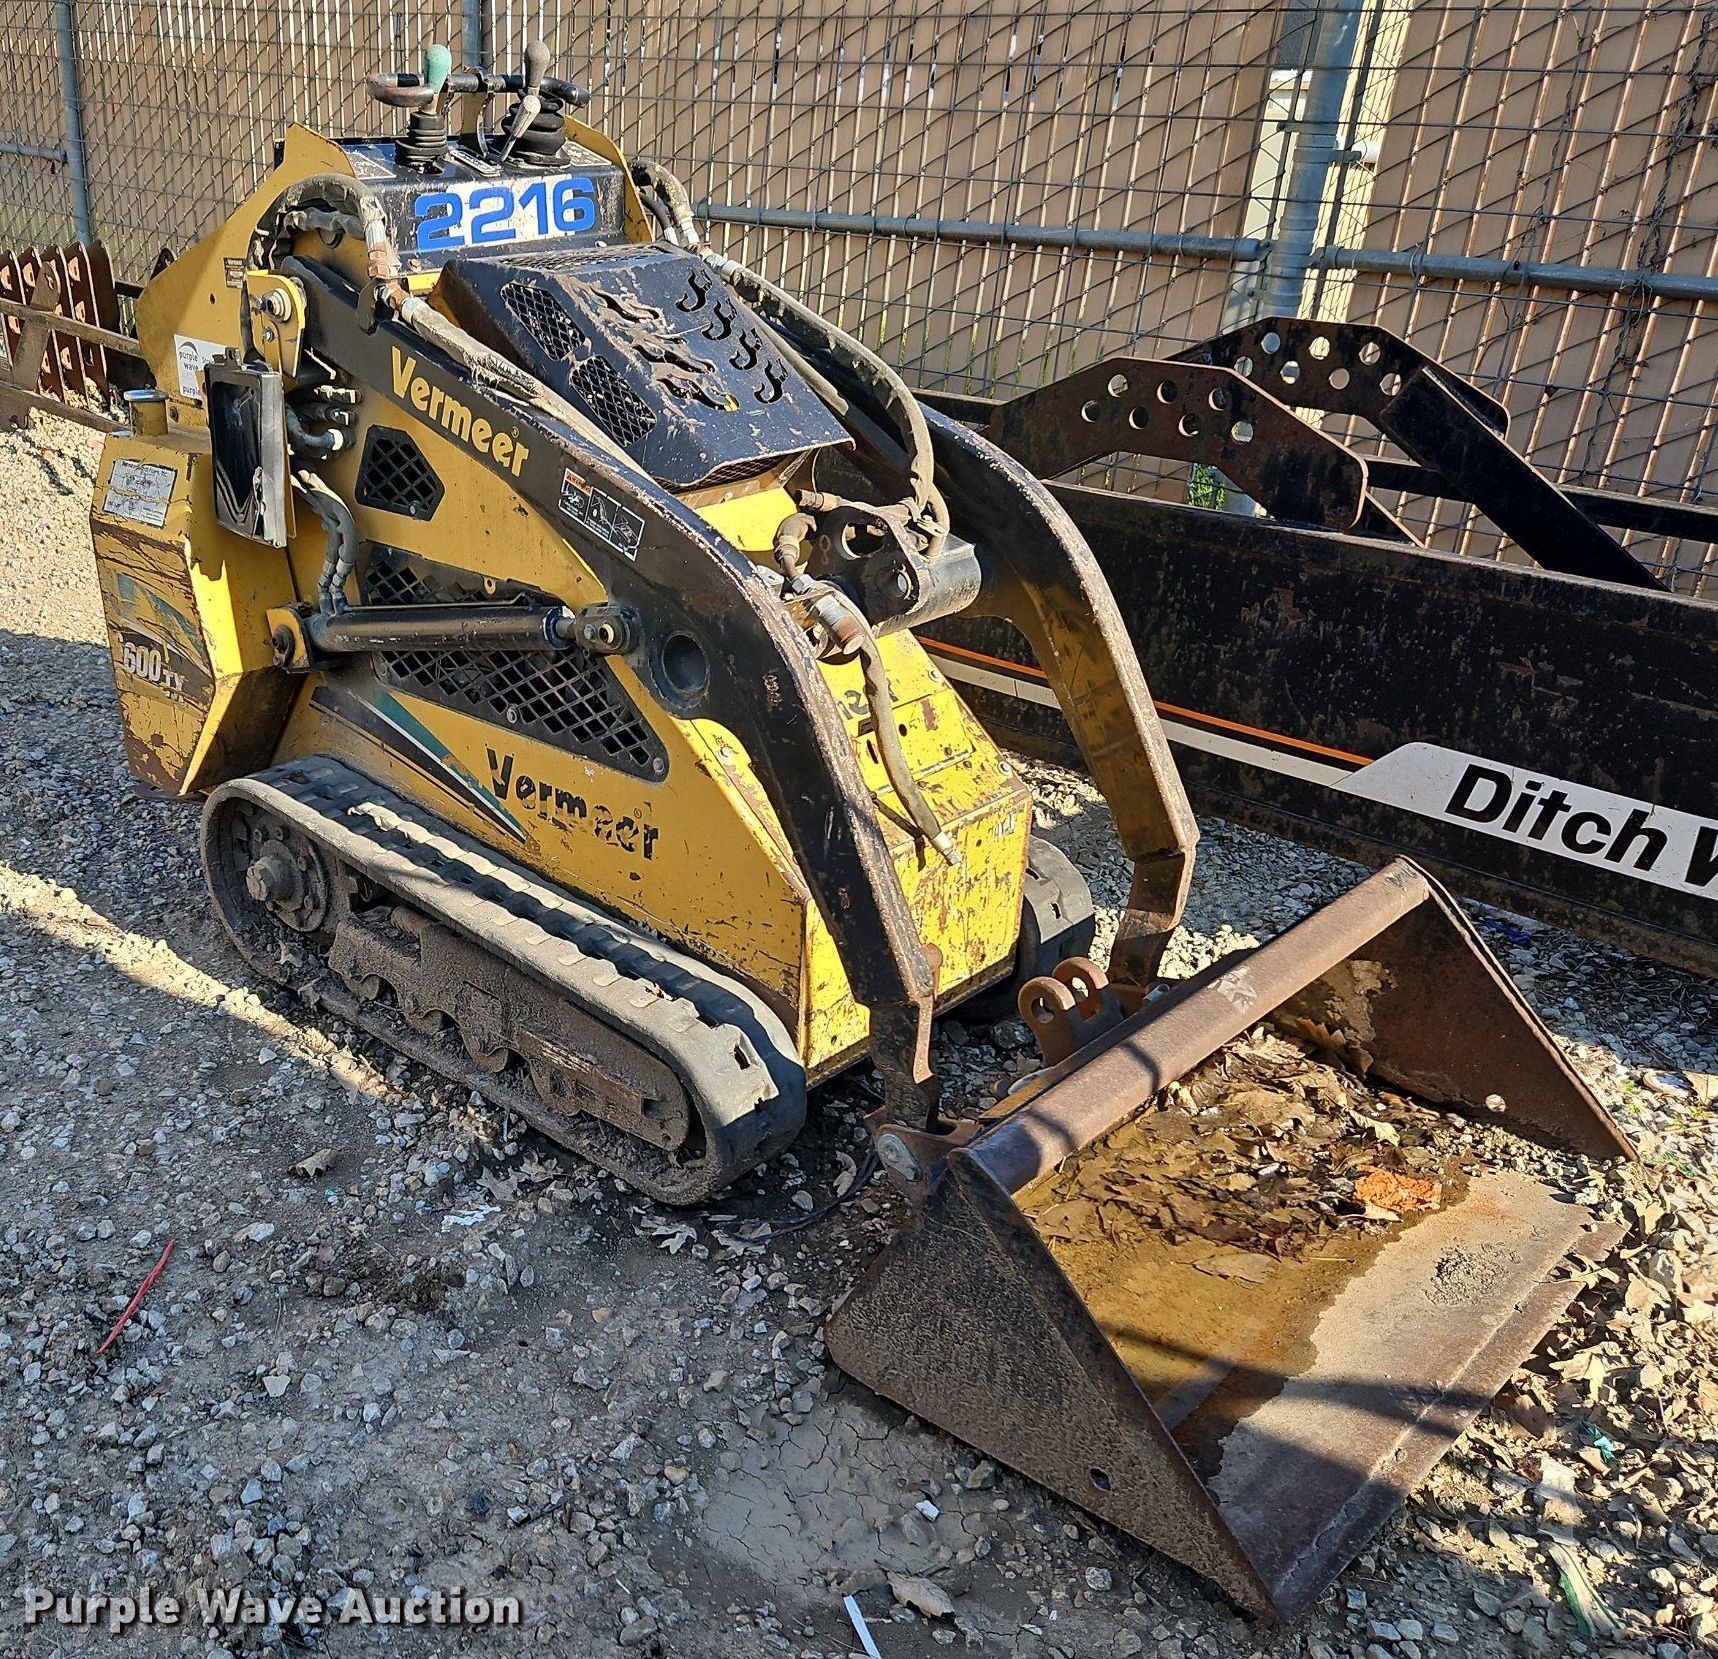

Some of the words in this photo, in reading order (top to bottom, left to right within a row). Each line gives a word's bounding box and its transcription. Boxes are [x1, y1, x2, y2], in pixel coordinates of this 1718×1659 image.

[414, 177, 597, 251] 2216
[179, 350, 198, 363] purple
[184, 362, 199, 372] wave
[391, 345, 530, 478] Vermeer
[1444, 763, 1668, 872] Ditch
